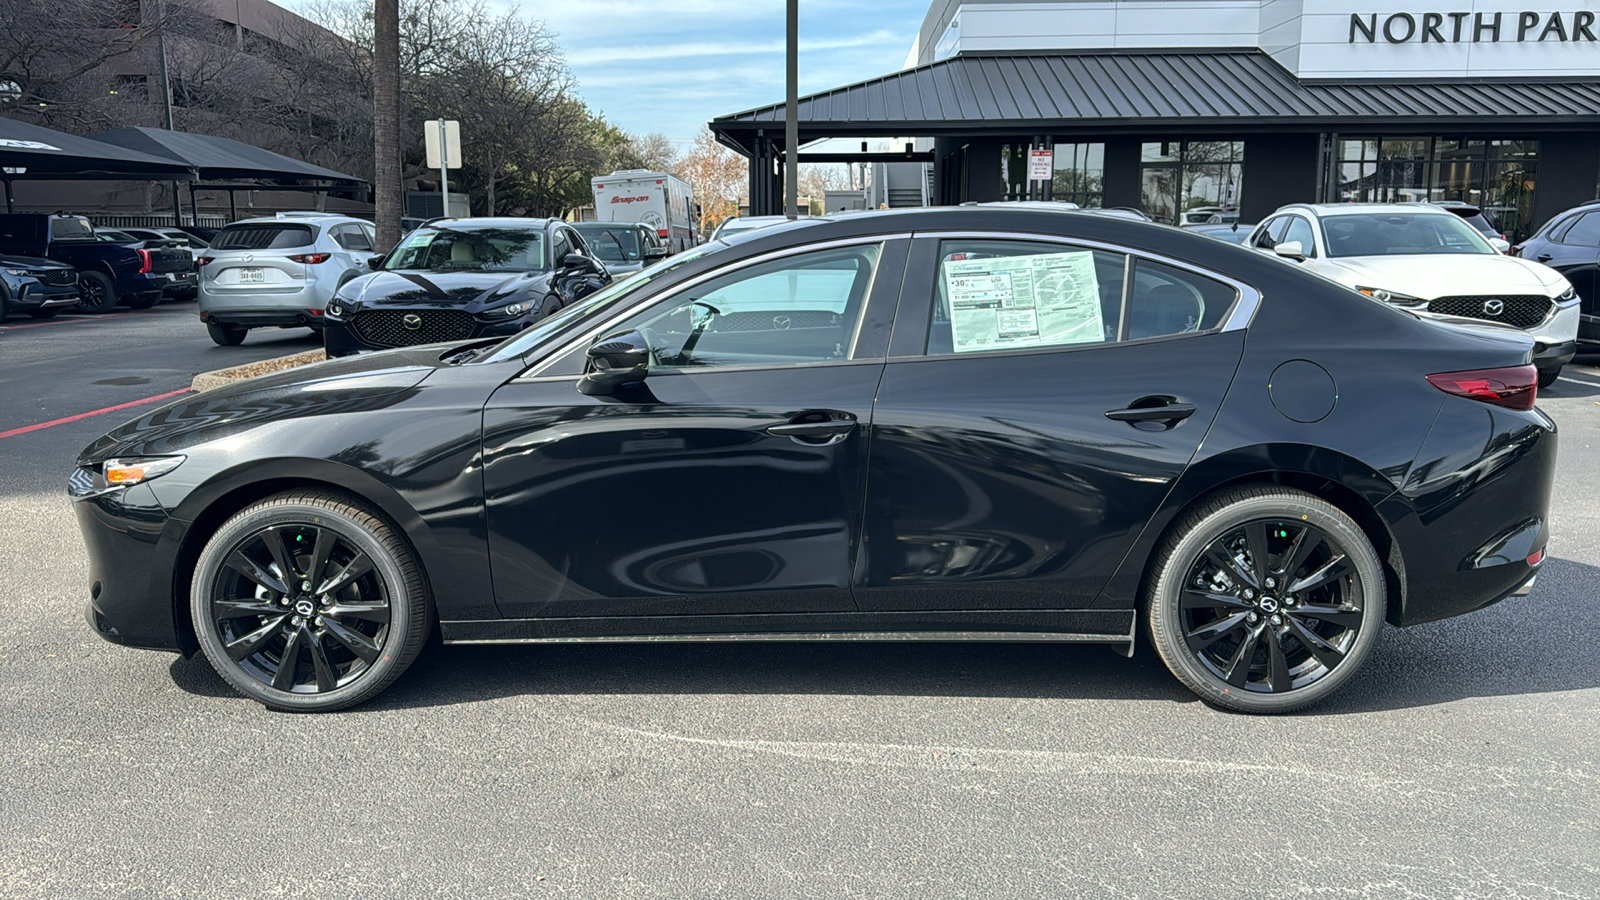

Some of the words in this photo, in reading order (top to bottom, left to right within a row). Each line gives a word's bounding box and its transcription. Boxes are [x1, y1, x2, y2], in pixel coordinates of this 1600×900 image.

[1348, 12, 1502, 44] NORTH
[1516, 11, 1598, 43] PAR
[610, 195, 649, 204] Snap-on
